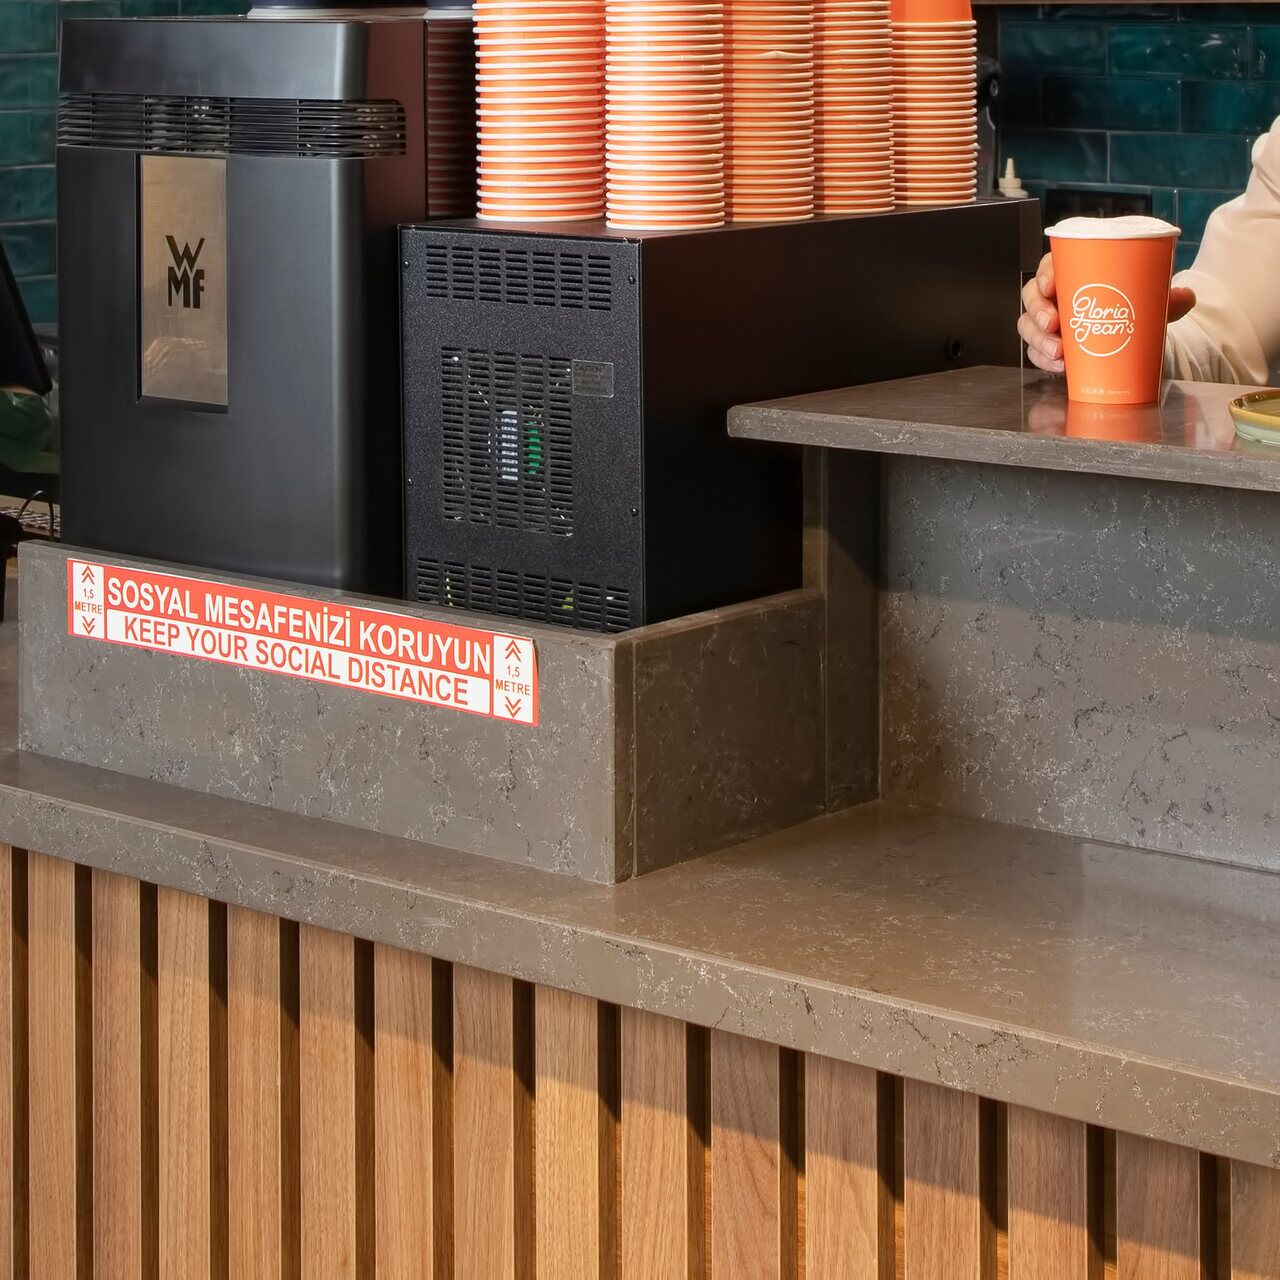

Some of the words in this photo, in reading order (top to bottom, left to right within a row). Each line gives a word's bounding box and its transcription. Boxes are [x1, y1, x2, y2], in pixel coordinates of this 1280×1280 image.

[1070, 296, 1129, 328] Gloria
[1075, 320, 1135, 343] Jean's
[83, 588, 95, 600] 1,5
[74, 600, 103, 615] METRE
[107, 577, 199, 619] SOSYAL
[205, 593, 351, 648] MESAFENİZİ
[359, 620, 491, 674] KORUYUN
[124, 615, 180, 647] KEEP
[186, 626, 248, 661] YOUR
[255, 640, 341, 680] SOCIAL
[348, 651, 468, 706] DISTANCE
[506, 665, 520, 678] 1,5
[495, 679, 531, 696] METRE
